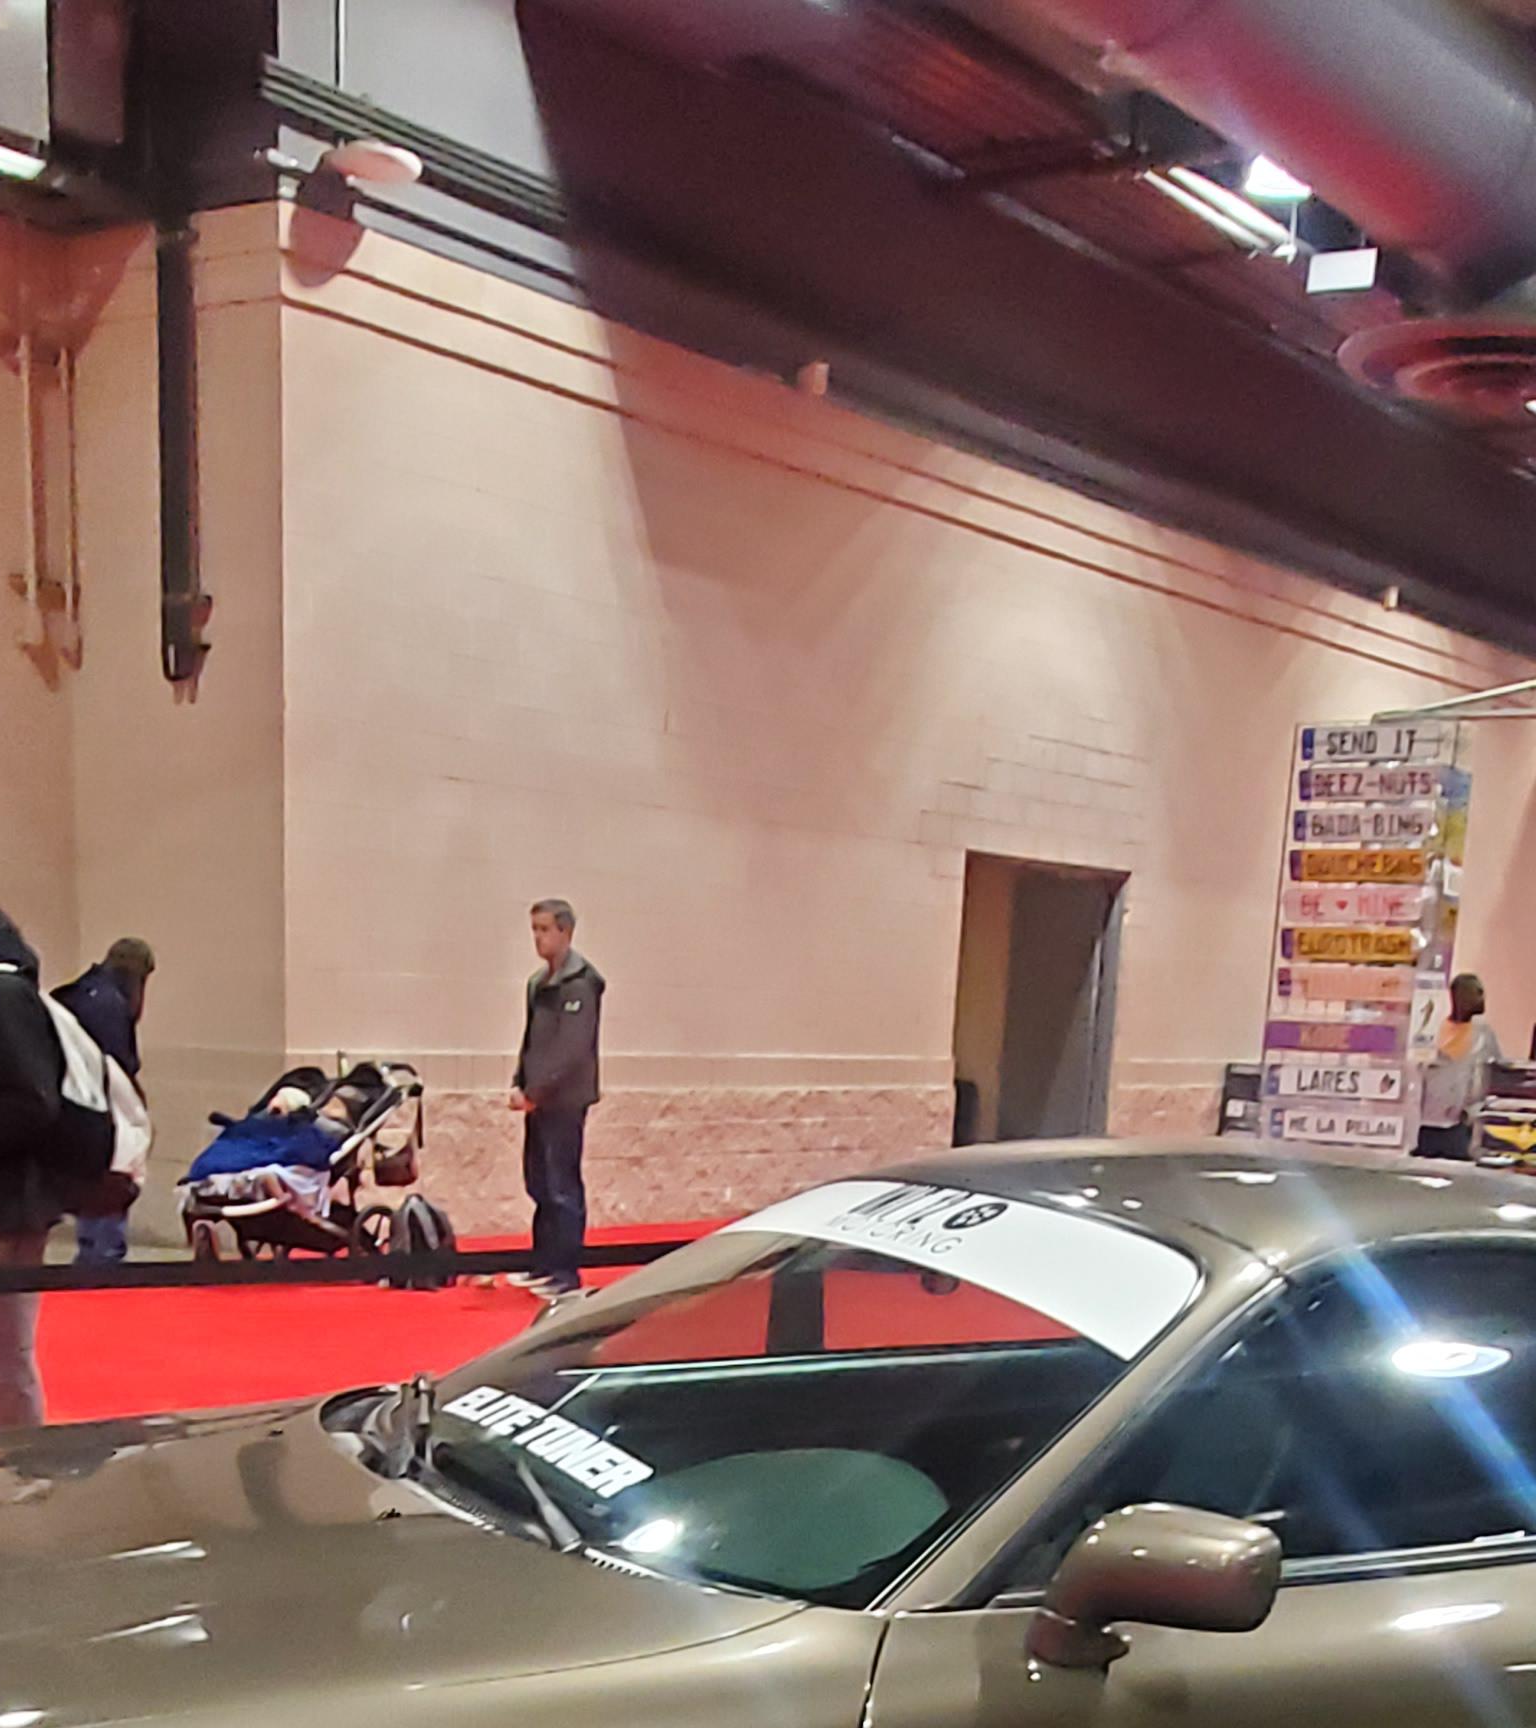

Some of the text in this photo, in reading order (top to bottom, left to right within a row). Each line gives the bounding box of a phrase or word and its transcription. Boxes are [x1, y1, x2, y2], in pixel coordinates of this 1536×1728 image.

[1326, 729, 1416, 756] SEND IT
[1296, 1069, 1360, 1093] LARES
[1315, 1118, 1336, 1133] LA
[442, 1386, 655, 1499] ELITE TUNER
